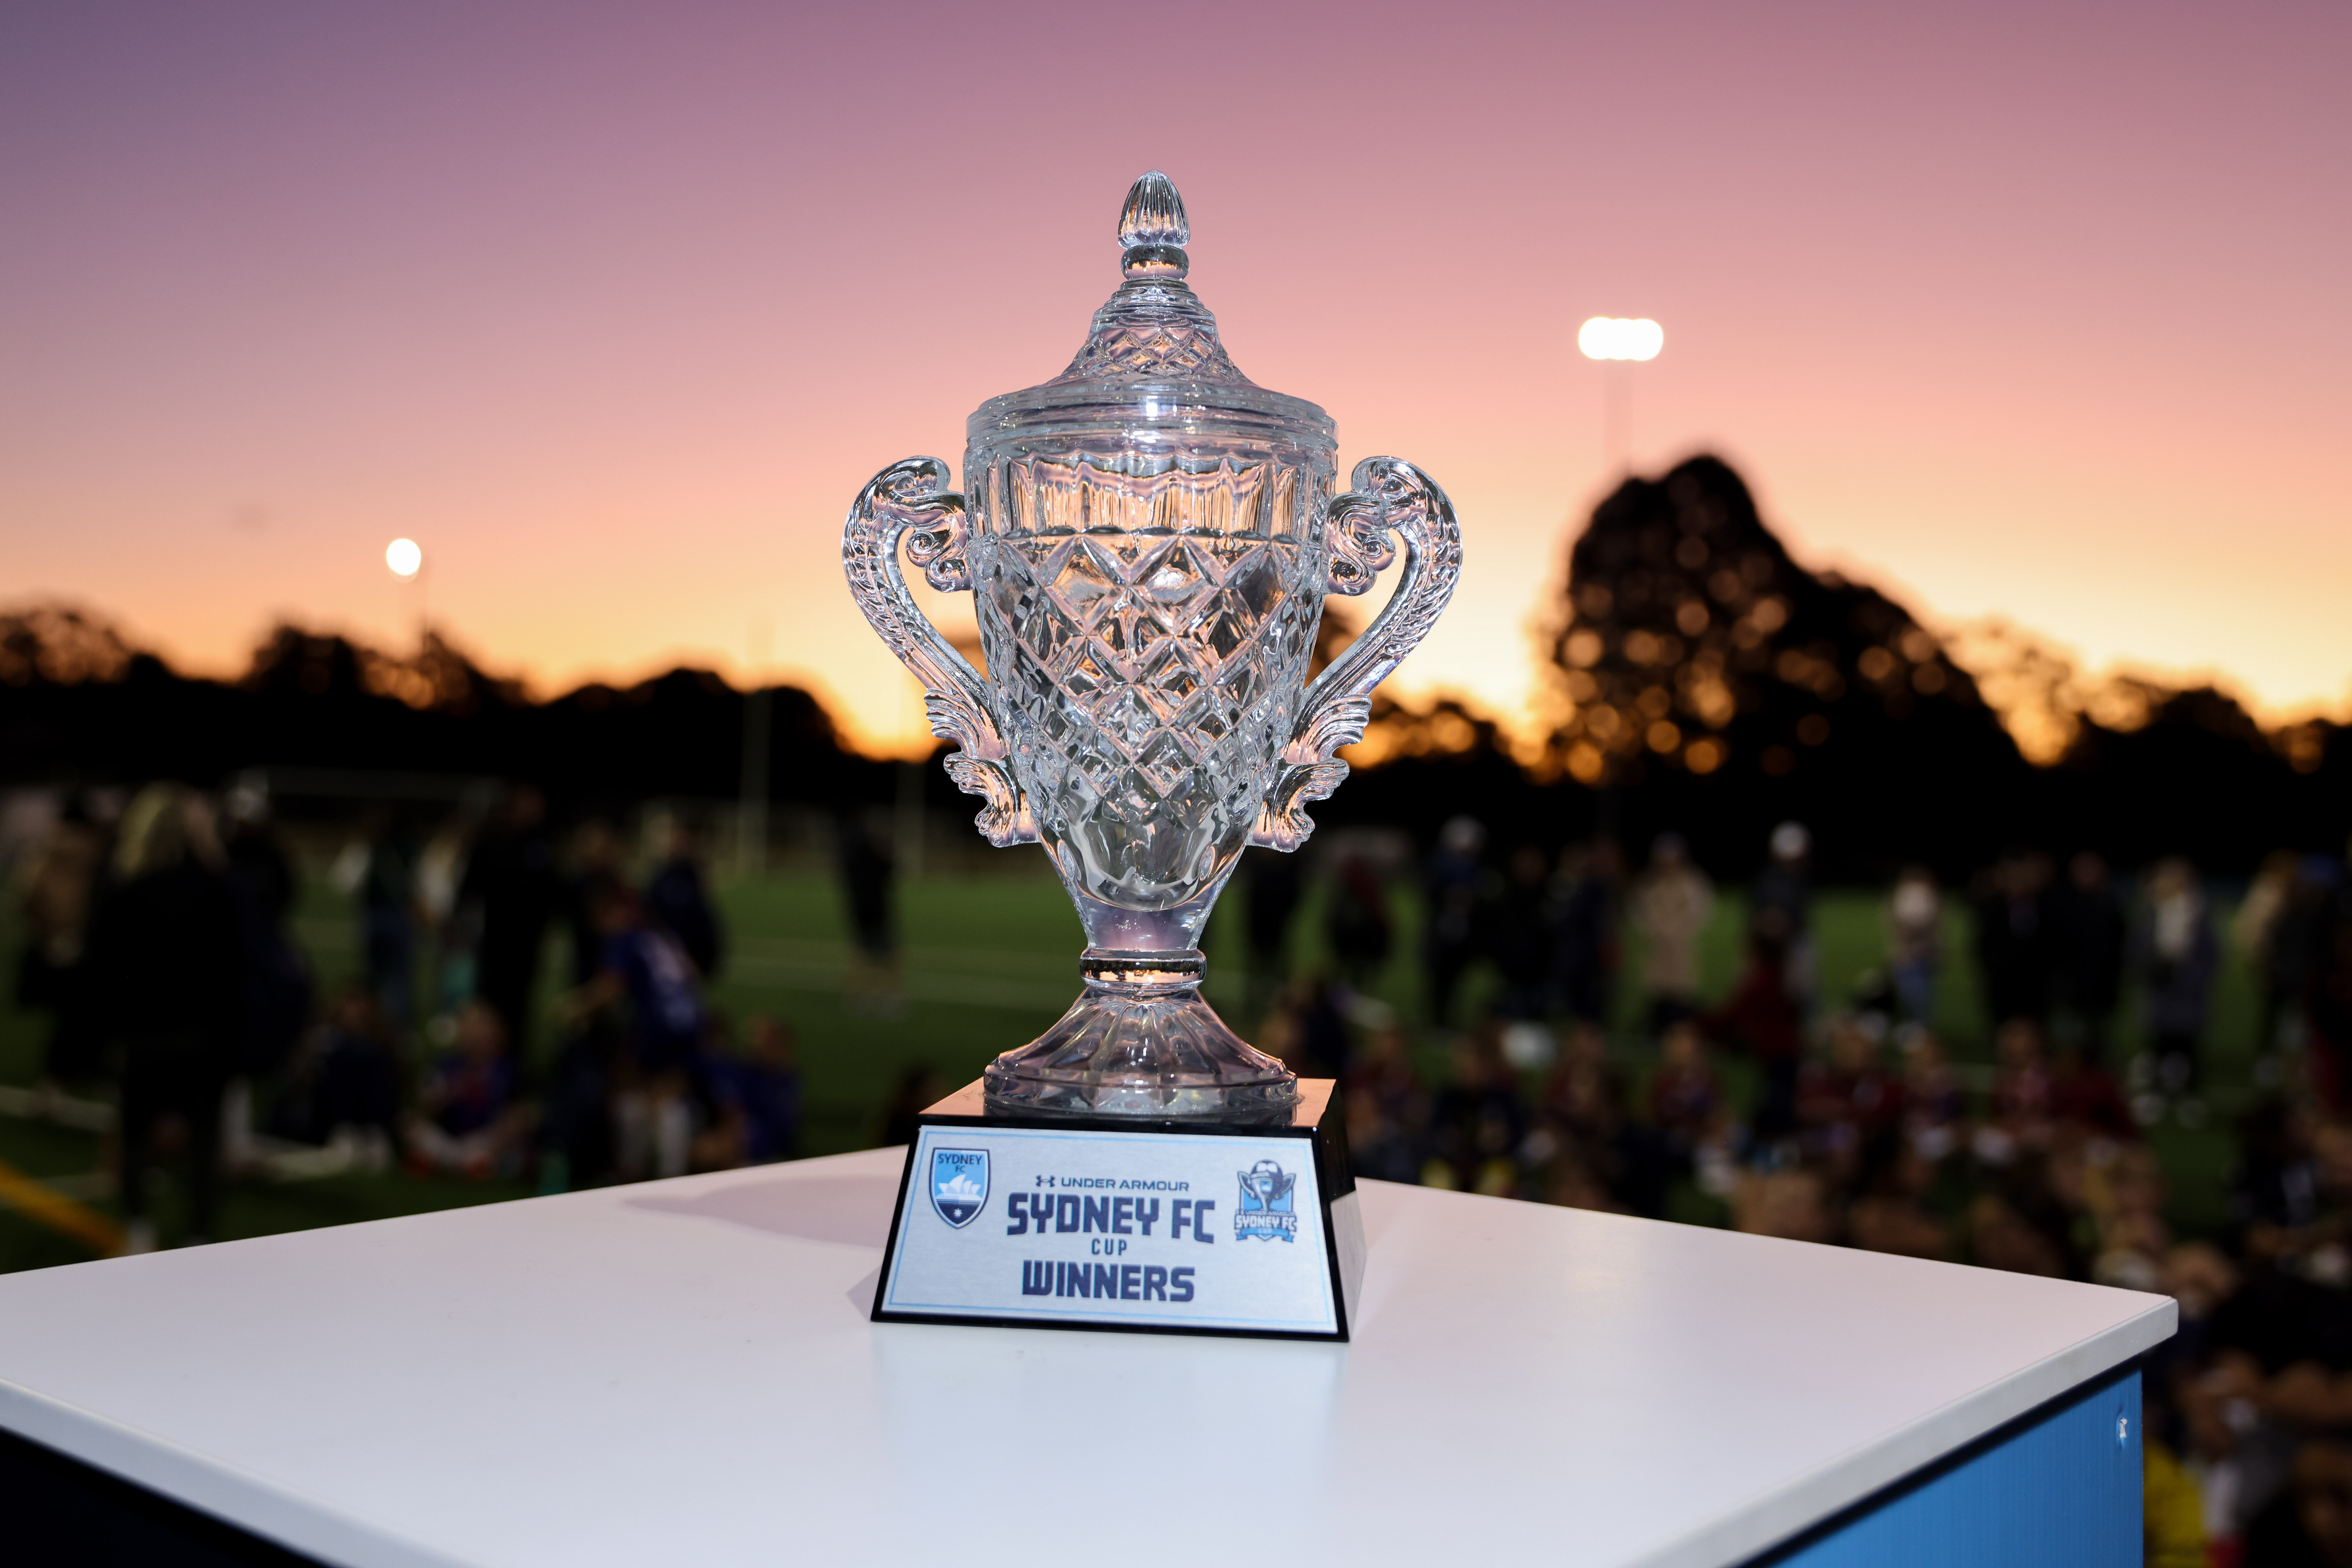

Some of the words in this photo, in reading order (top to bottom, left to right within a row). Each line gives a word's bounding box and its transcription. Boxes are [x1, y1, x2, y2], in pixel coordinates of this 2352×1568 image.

[938, 1153, 983, 1165] SYDNEY
[1061, 1177, 1116, 1189] UNDER
[1119, 1179, 1189, 1191] ARMOUR
[1007, 1192, 1159, 1236] SYDNEY
[1171, 1199, 1215, 1243] FC
[1236, 1215, 1279, 1229] SYDNEY
[1282, 1216, 1296, 1230] FC
[1091, 1238, 1127, 1255] CUP
[1022, 1259, 1195, 1302] WINNERS
